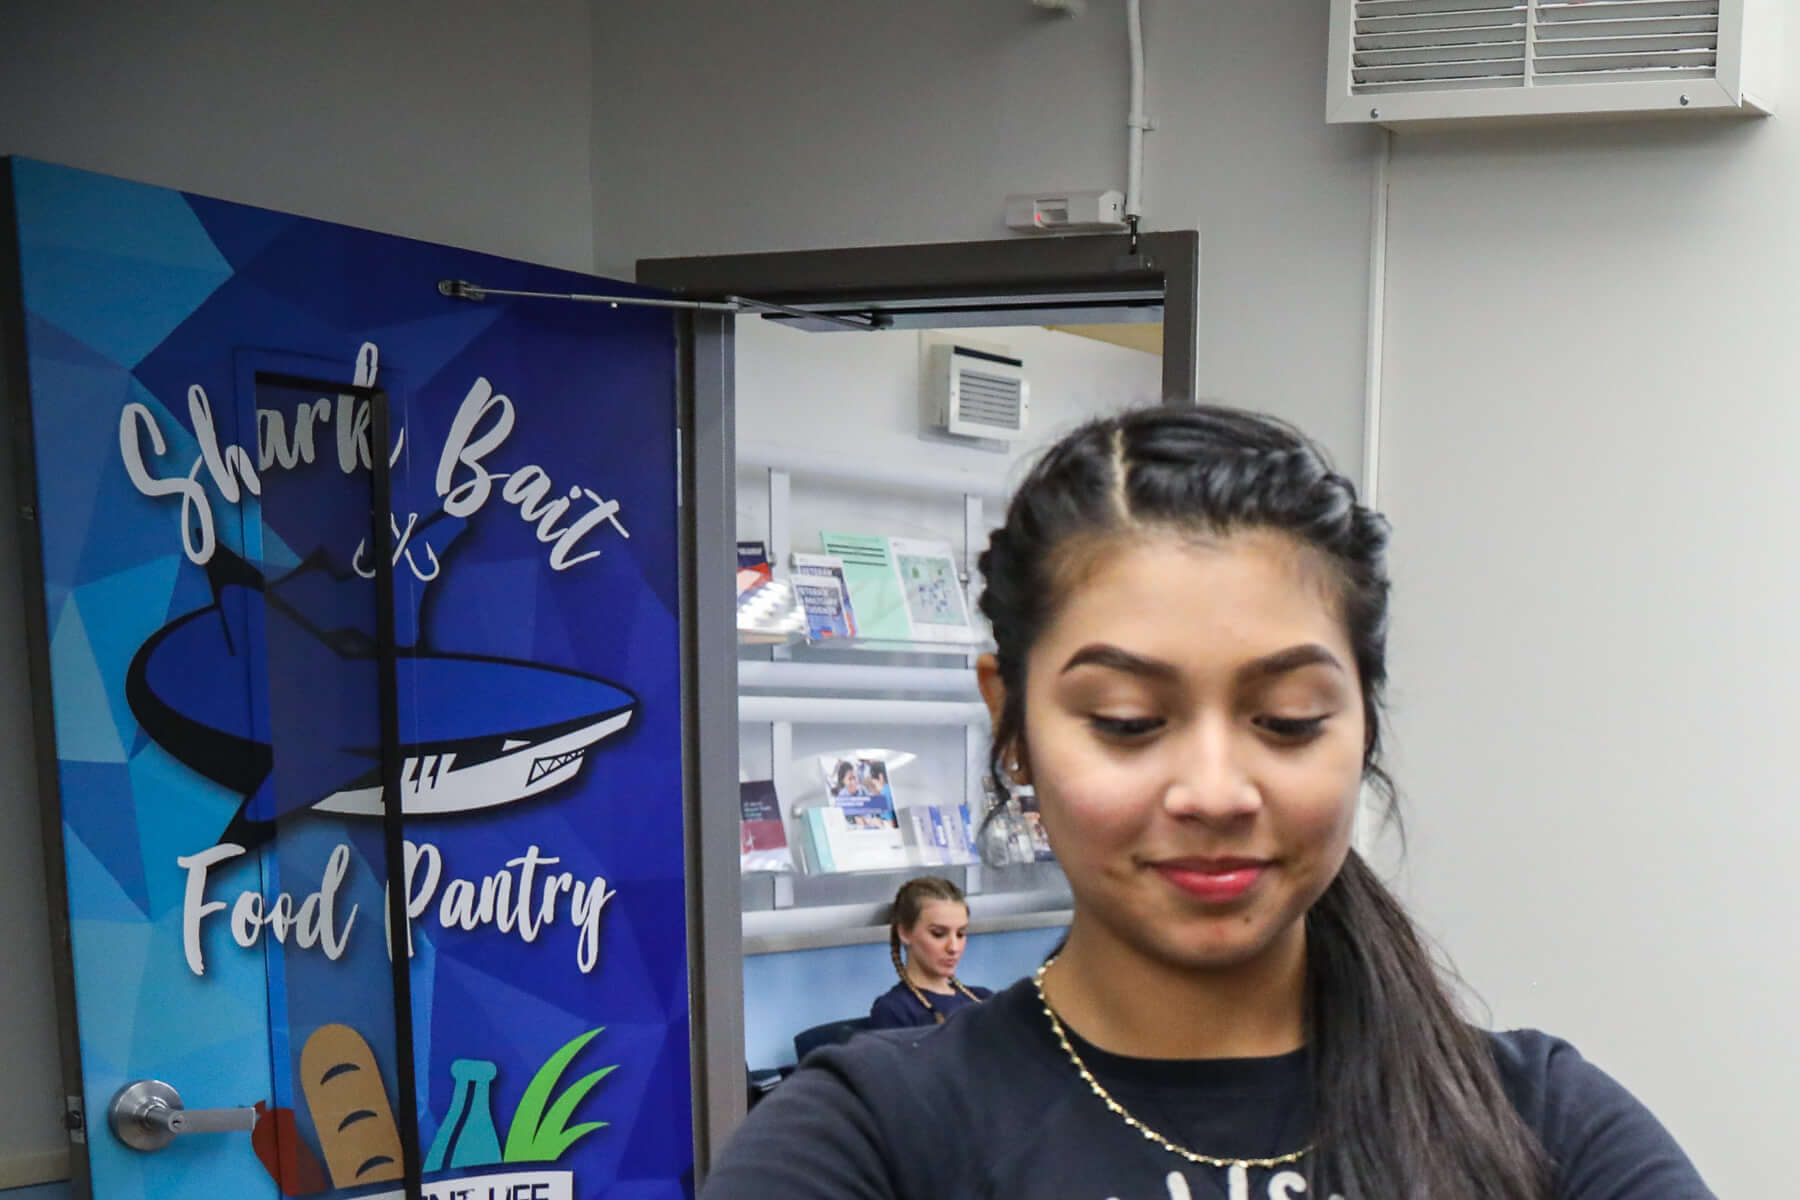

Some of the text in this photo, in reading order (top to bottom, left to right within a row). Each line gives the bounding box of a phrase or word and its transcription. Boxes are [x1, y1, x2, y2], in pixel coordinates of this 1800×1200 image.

[119, 341, 630, 571] Shark Bait
[177, 839, 617, 976] Food Pantry
